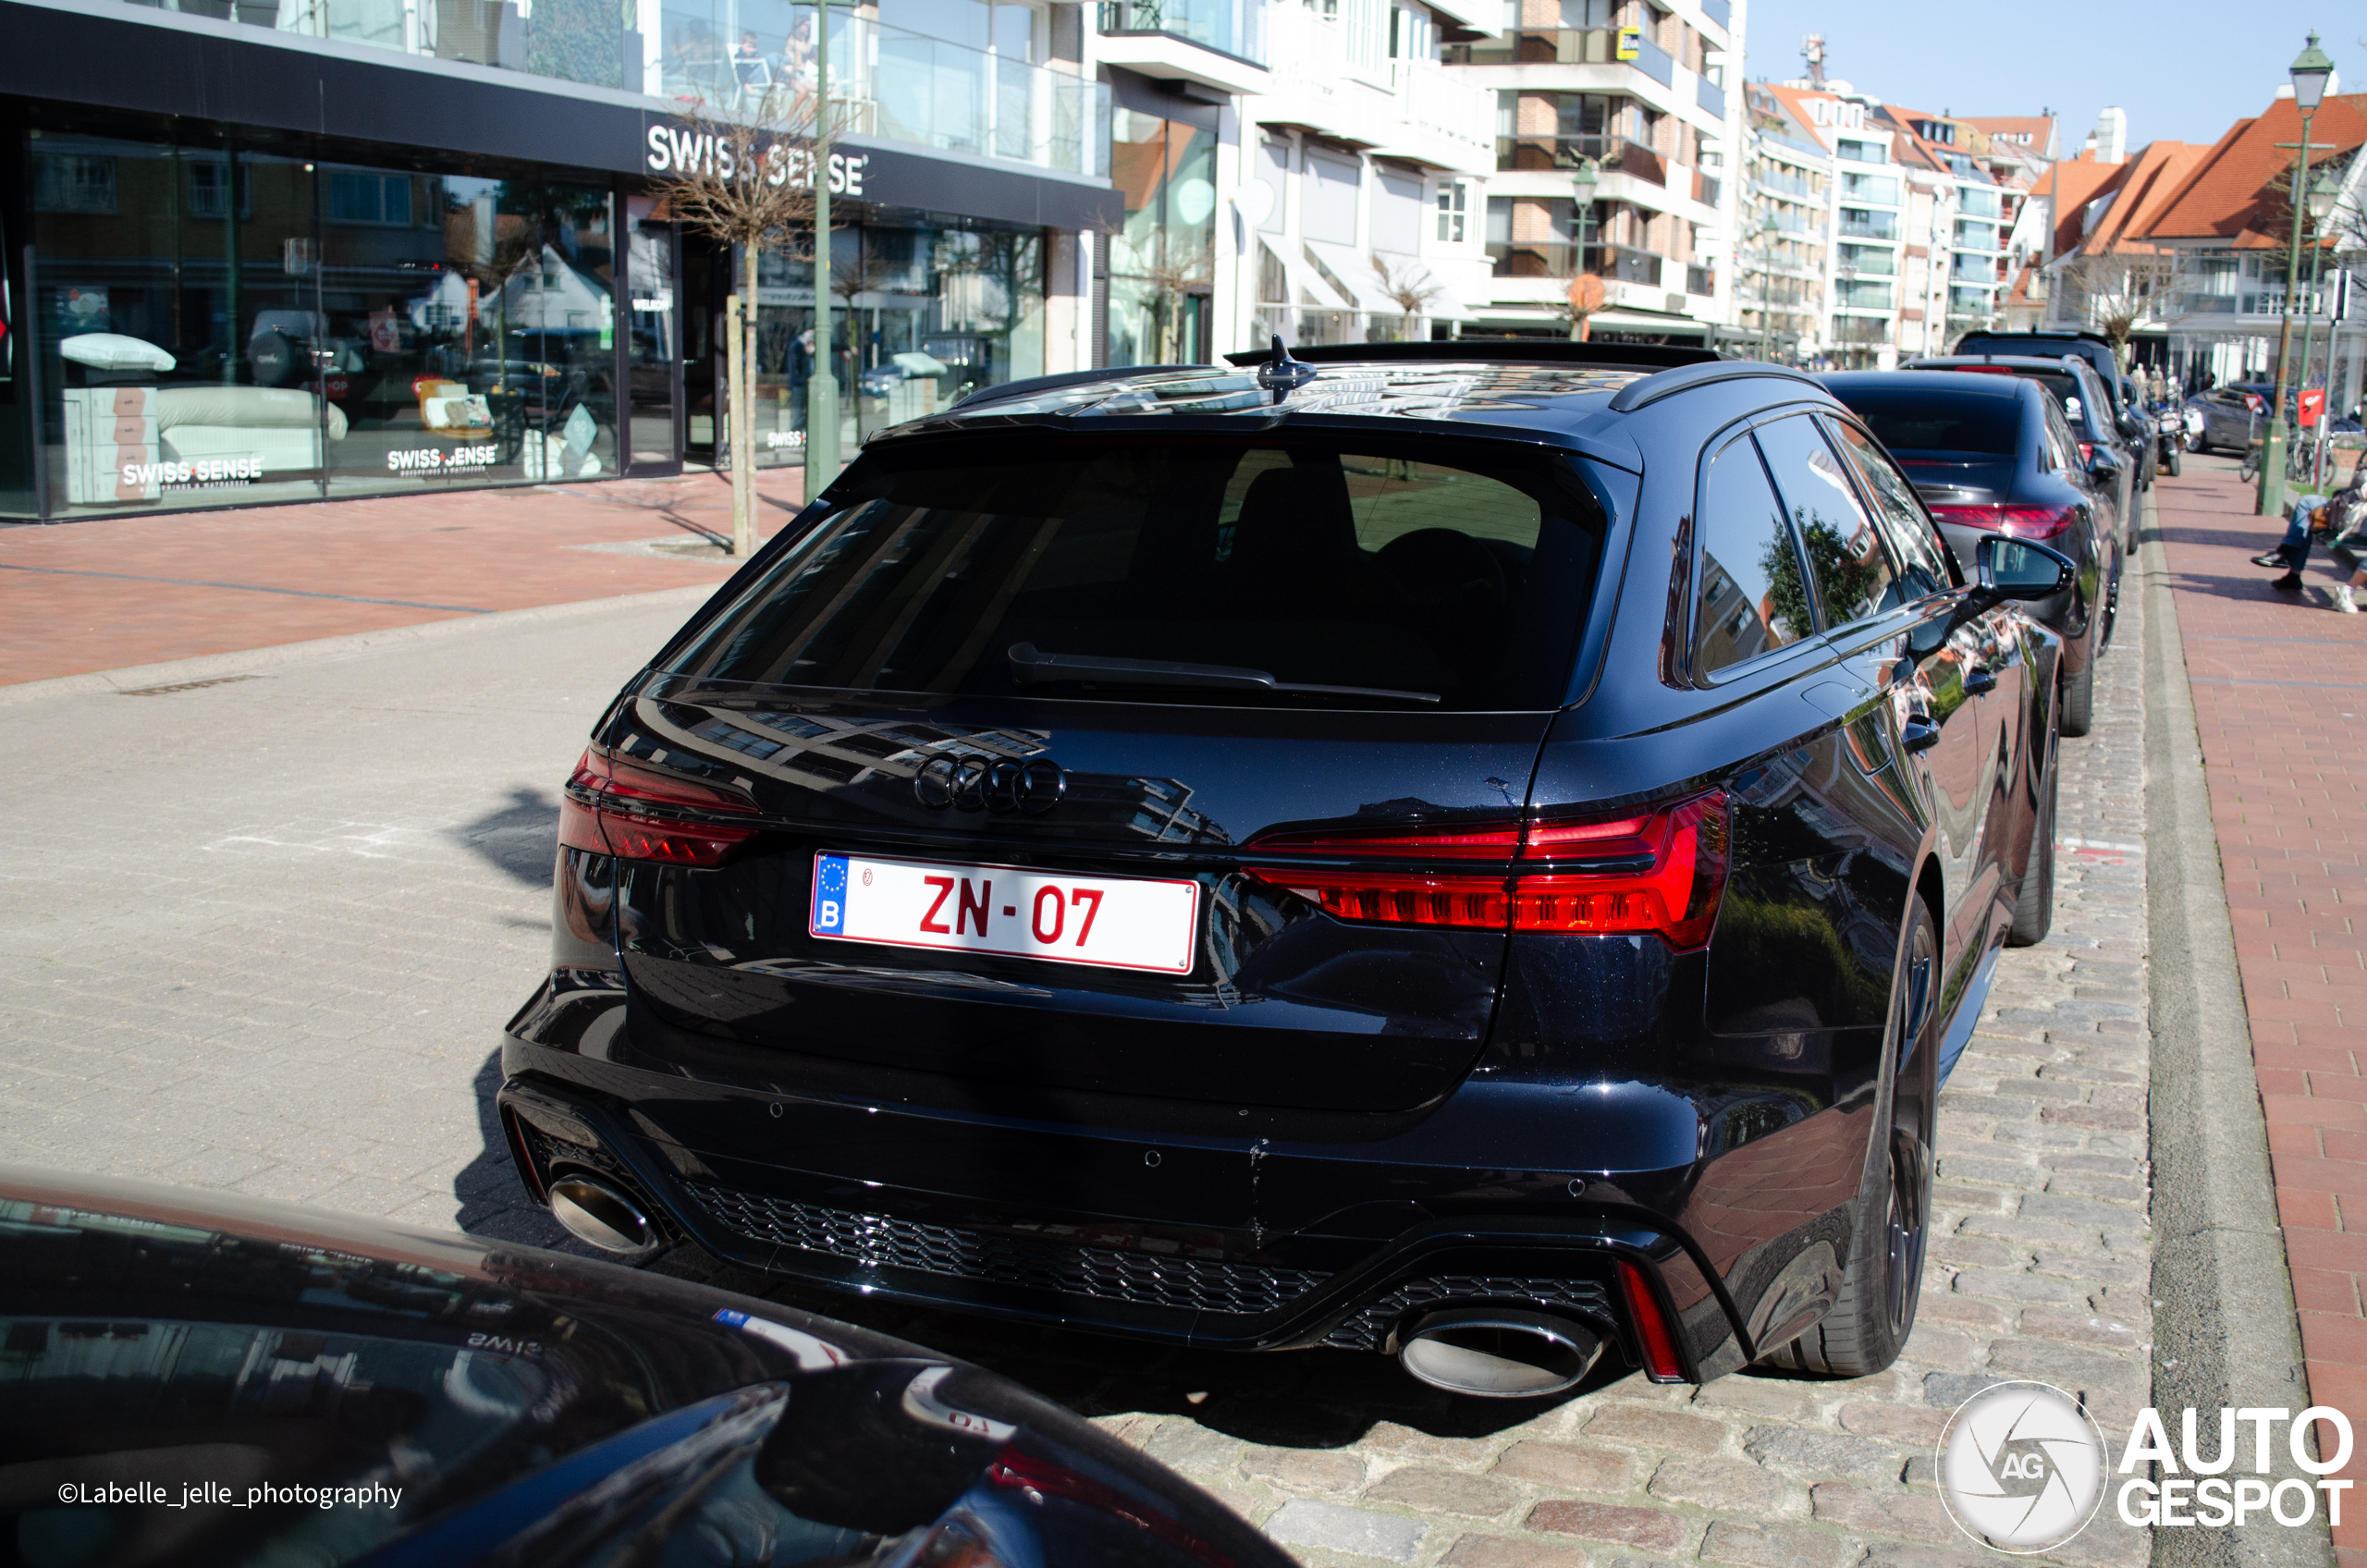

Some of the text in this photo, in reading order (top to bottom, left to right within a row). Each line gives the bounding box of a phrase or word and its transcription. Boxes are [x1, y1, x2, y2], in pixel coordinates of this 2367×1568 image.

[767, 431, 802, 448] SWISS
[123, 458, 263, 486] SWISS SENSE
[387, 448, 441, 471] SWISS
[820, 900, 840, 928] B
